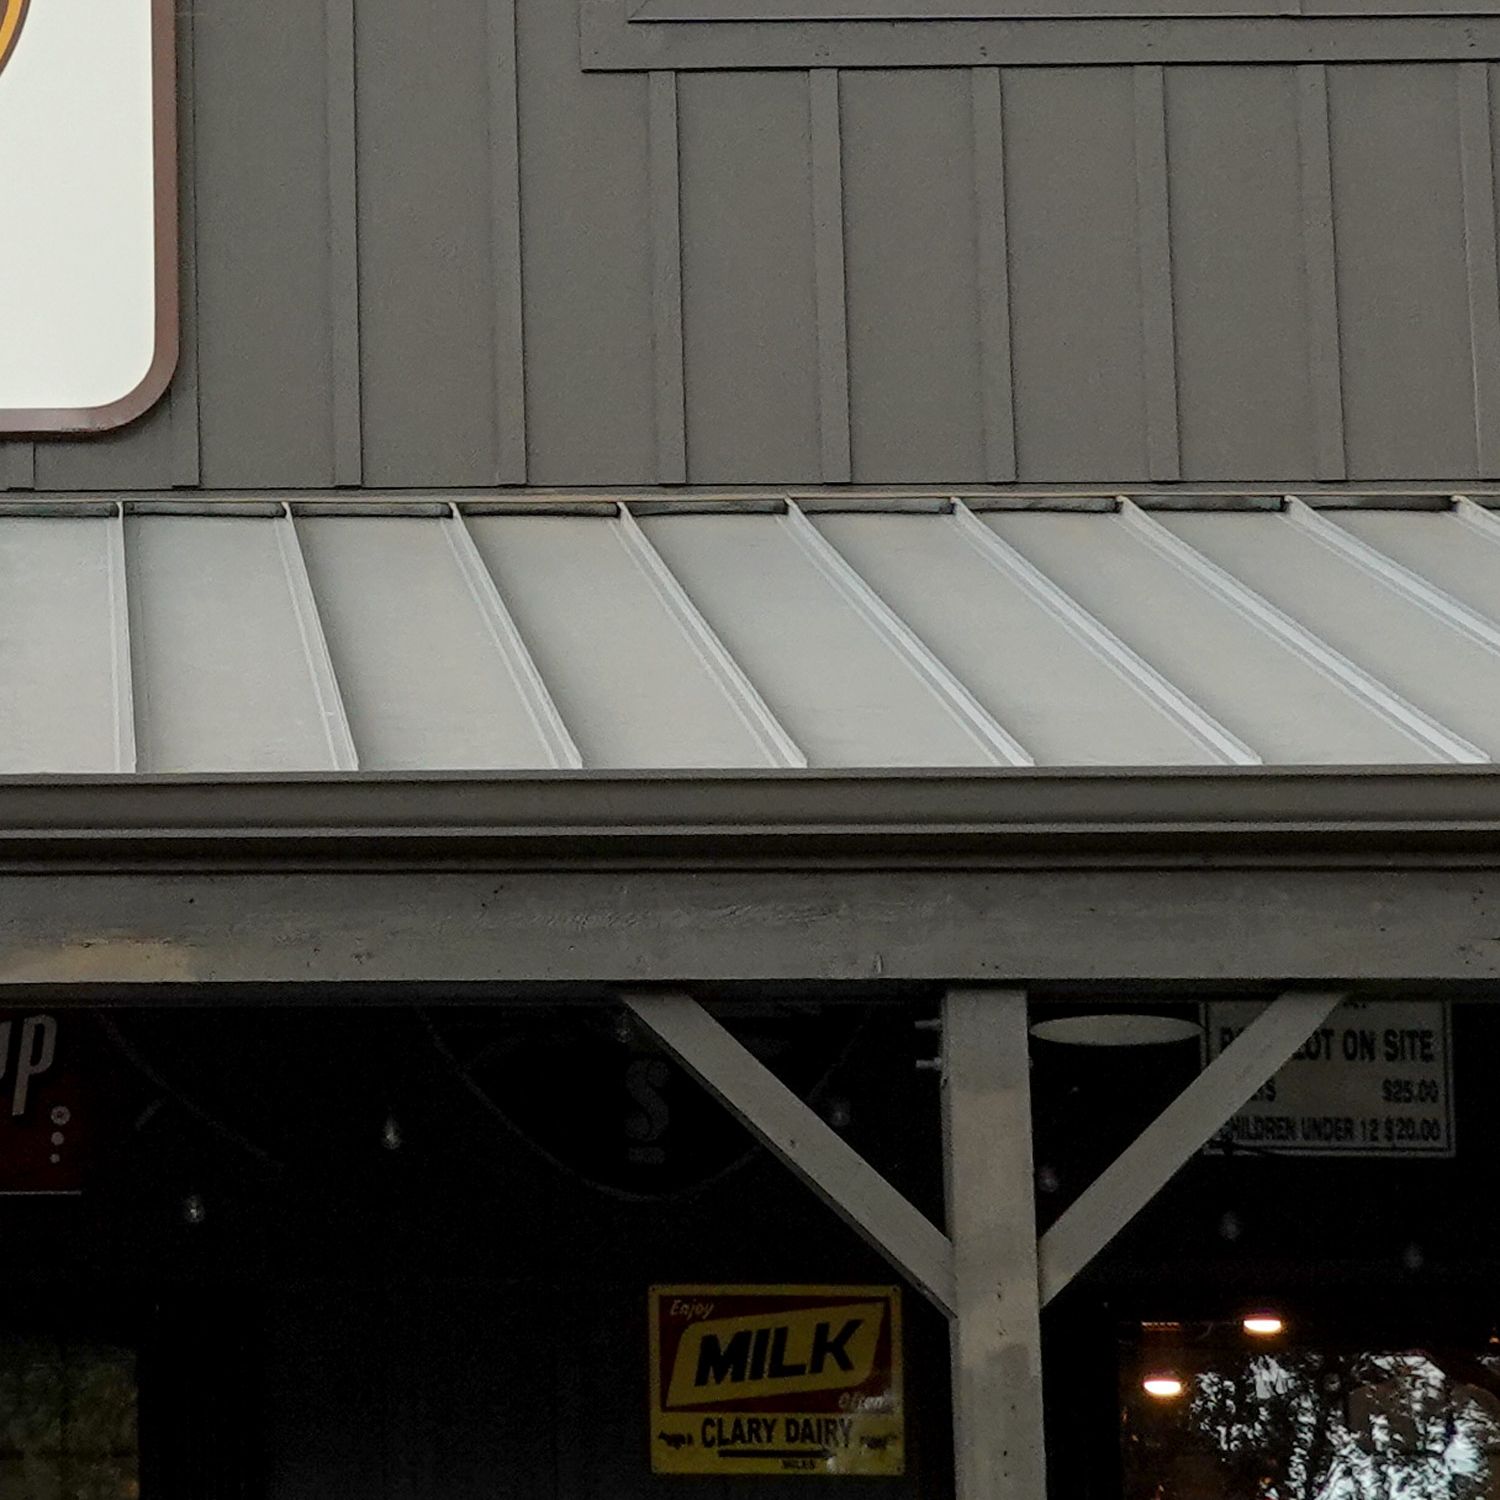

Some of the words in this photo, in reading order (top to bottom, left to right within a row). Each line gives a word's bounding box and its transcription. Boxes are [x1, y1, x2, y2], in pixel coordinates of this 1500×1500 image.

[1343, 1029, 1375, 1061] ON
[1384, 1029, 1434, 1062] SITE
[1302, 1117, 1353, 1142] UNDER
[669, 1299, 714, 1321] Enjoy
[694, 1320, 865, 1387] MILK
[701, 1417, 777, 1448] CLARY
[786, 1417, 852, 1448] DAIRY
